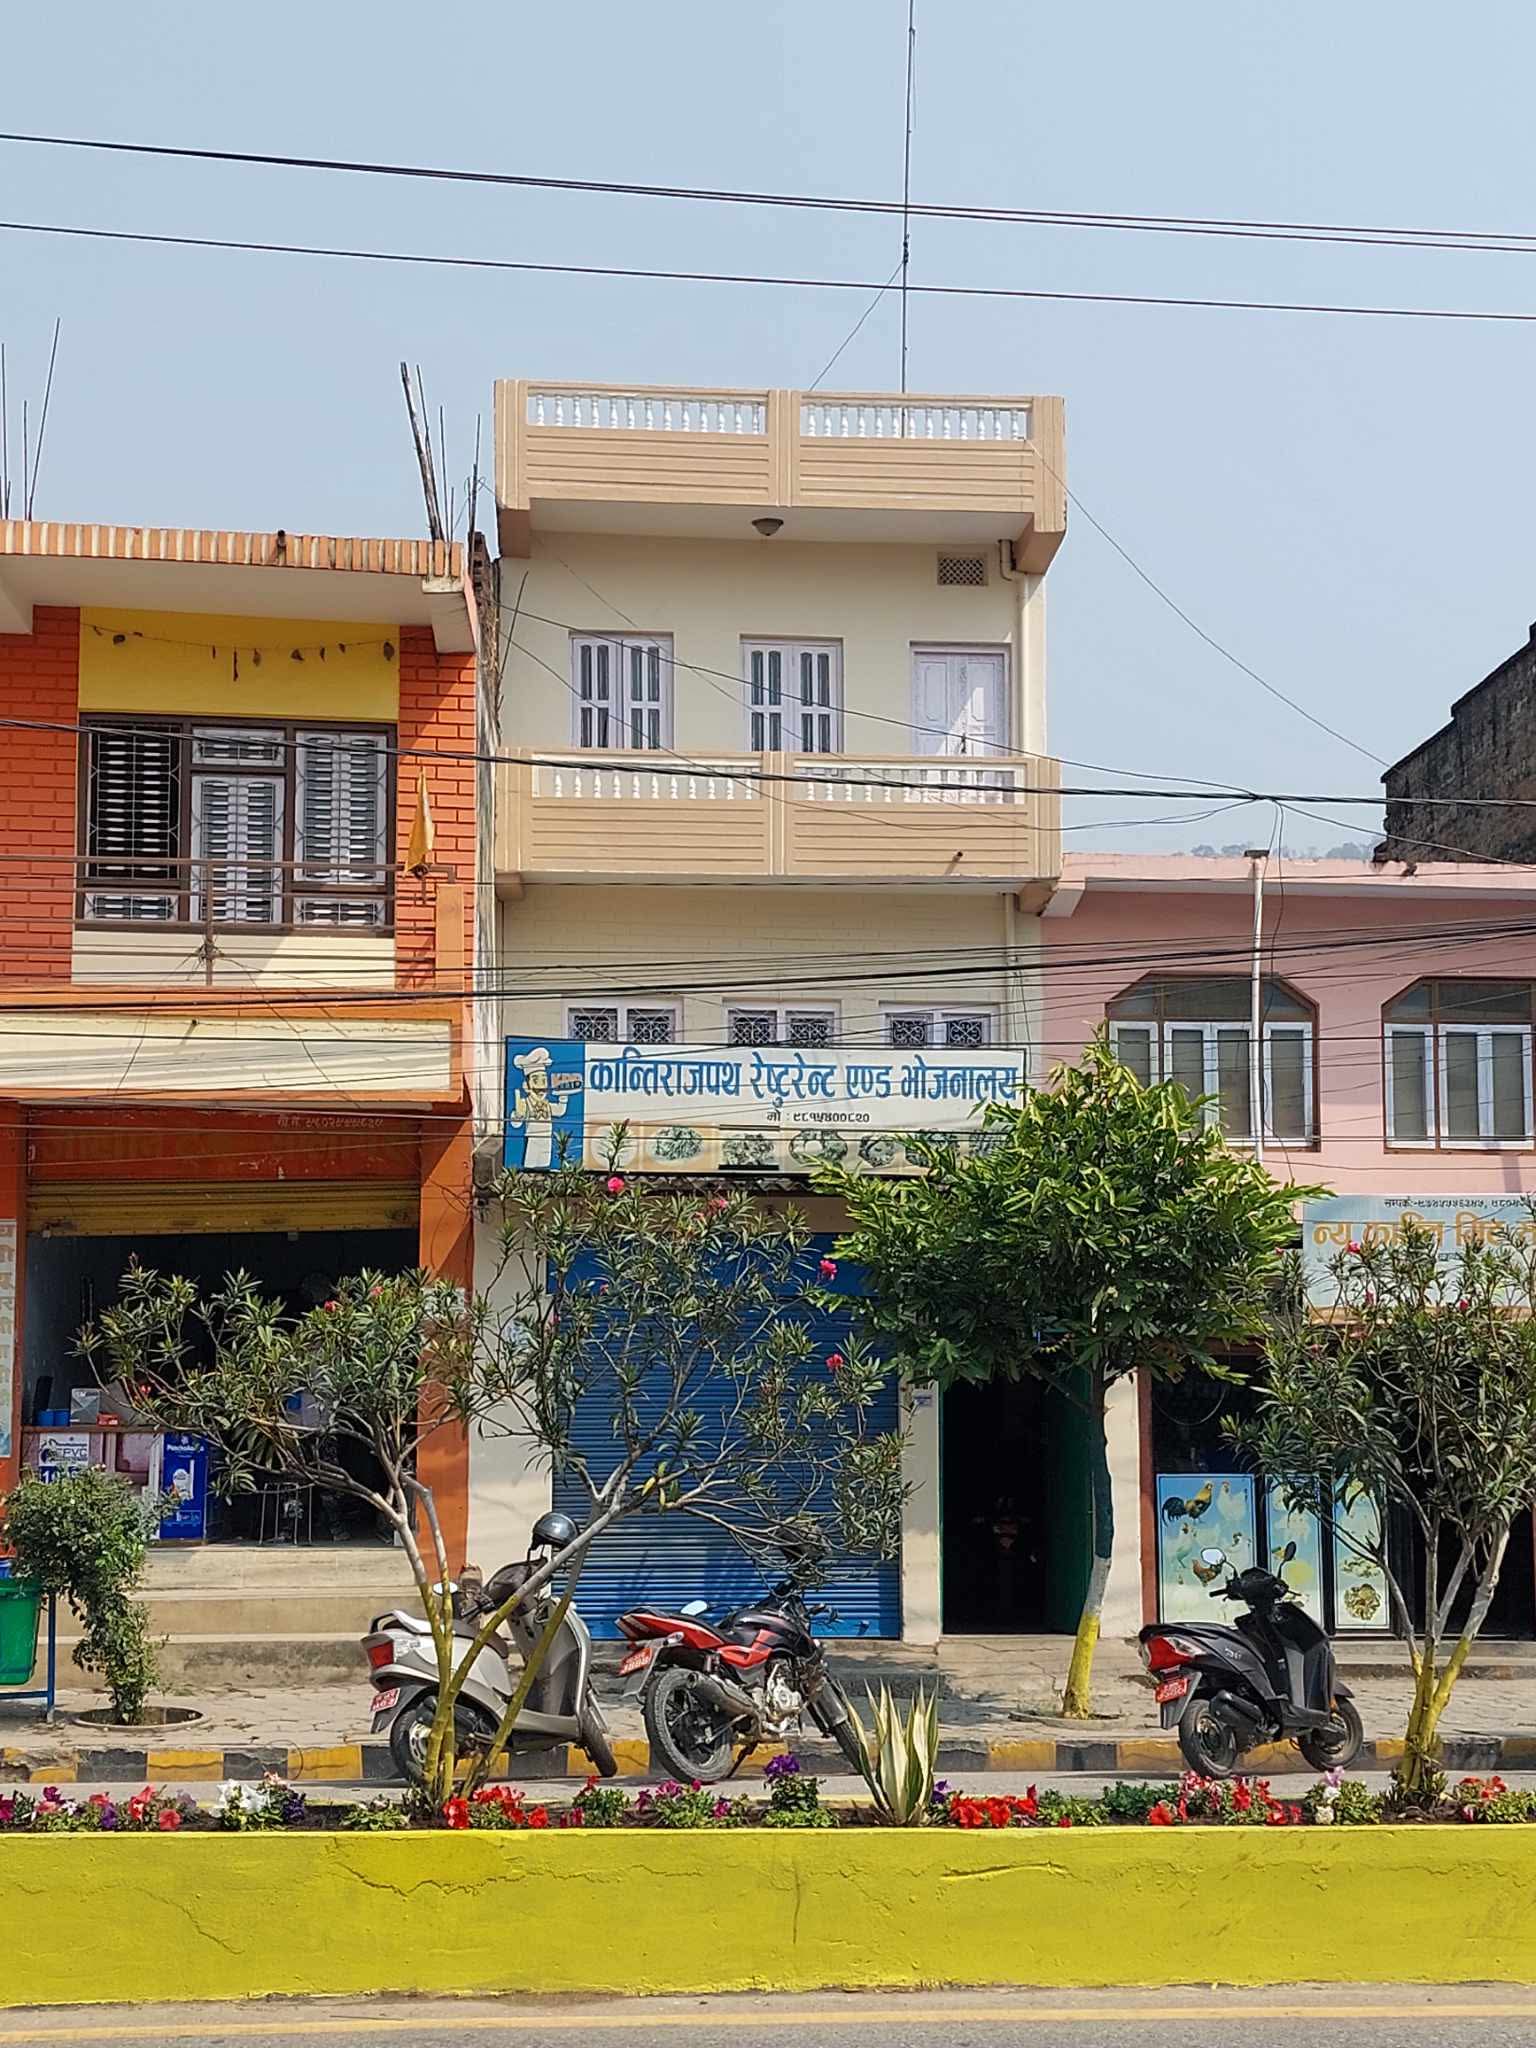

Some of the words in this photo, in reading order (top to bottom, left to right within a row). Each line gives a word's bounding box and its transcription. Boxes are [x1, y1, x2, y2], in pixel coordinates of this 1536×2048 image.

[589, 1046, 742, 1096] कान्तिराजपथ
[845, 1064, 893, 1098] एण्ड
[901, 1054, 1018, 1100] भोजनालय
